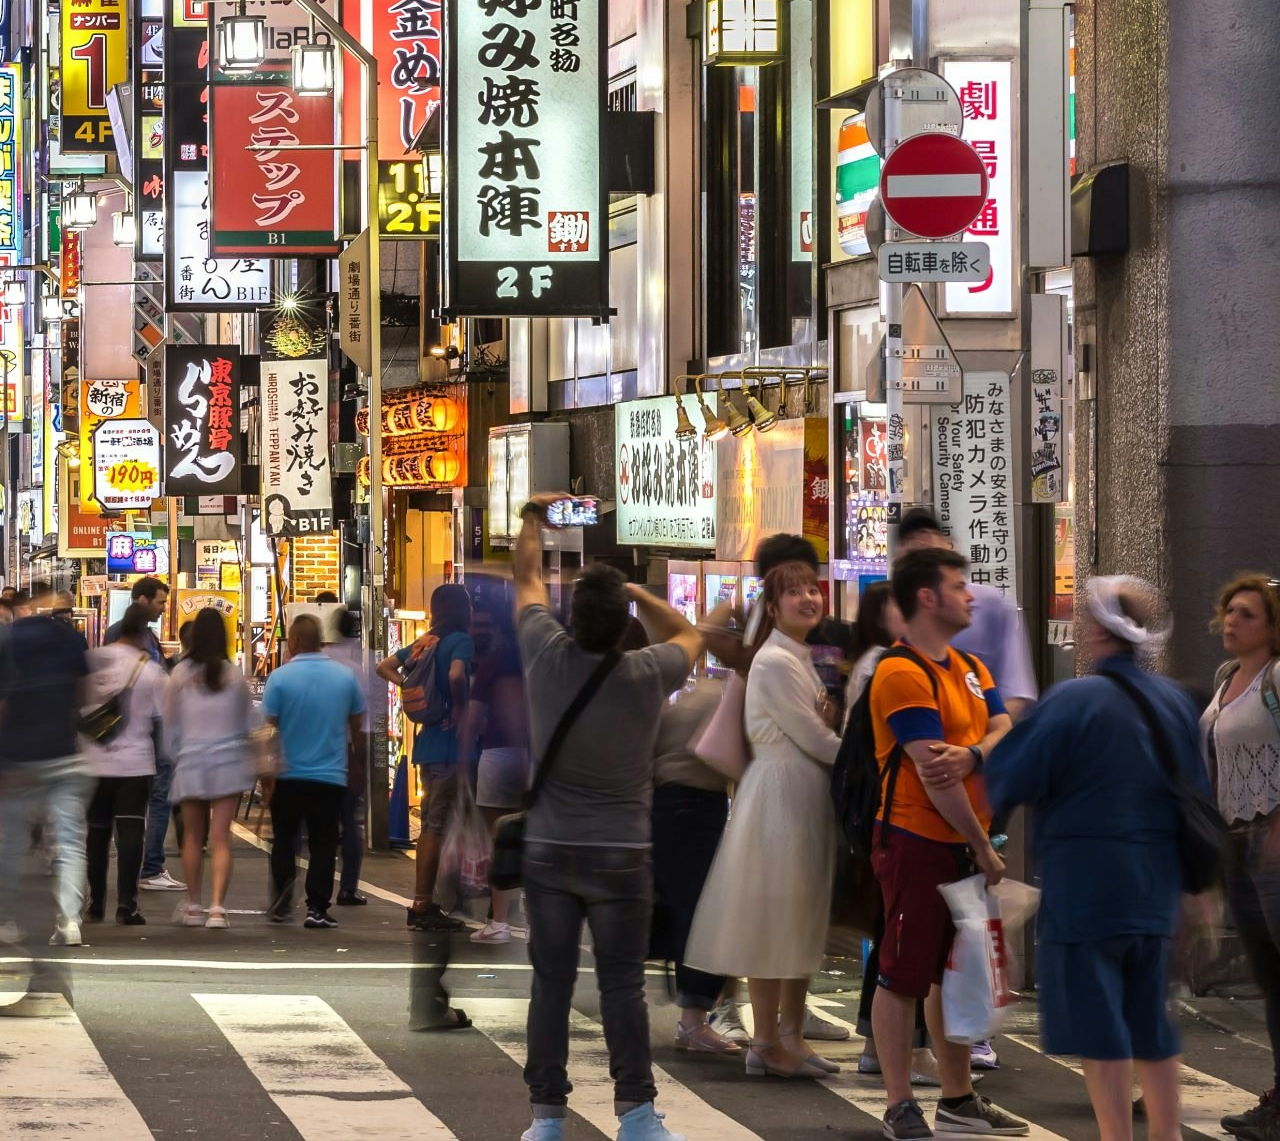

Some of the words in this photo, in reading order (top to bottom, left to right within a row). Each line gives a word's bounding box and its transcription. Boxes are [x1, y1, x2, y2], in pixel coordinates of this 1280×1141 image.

[73, 15, 119, 28] ナンバー
[72, 34, 107, 109] 1
[74, 121, 113, 143] 4F
[248, 91, 306, 227] ステップ
[267, 233, 287, 245] B1
[549, 213, 588, 244] 鋤
[557, 242, 578, 252] すき
[888, 251, 981, 275] 自転車を除く
[179, 256, 196, 301] 一番街
[236, 286, 269, 300] B1F
[495, 266, 552, 299] 2F
[348, 261, 361, 343] 劇場通り一番街
[89, 387, 125, 407] 新宿
[101, 405, 114, 416] の
[209, 357, 233, 450] 東京豚骨
[286, 372, 326, 495] お好み焼き
[937, 417, 950, 468] Security
[951, 419, 962, 448] Your
[271, 427, 281, 486] TEPPANYAKI
[111, 464, 153, 484] 190円
[951, 453, 965, 492] Safety
[939, 472, 951, 522] Camera
[965, 393, 991, 585] 防犯カメラ作動中
[73, 527, 102, 535] ONLINE
[299, 518, 331, 531] B1F
[93, 538, 102, 546] B1
[110, 535, 156, 573] 麻雀
[135, 539, 156, 547] フリー
[185, 596, 234, 614] リーチ麻雀
